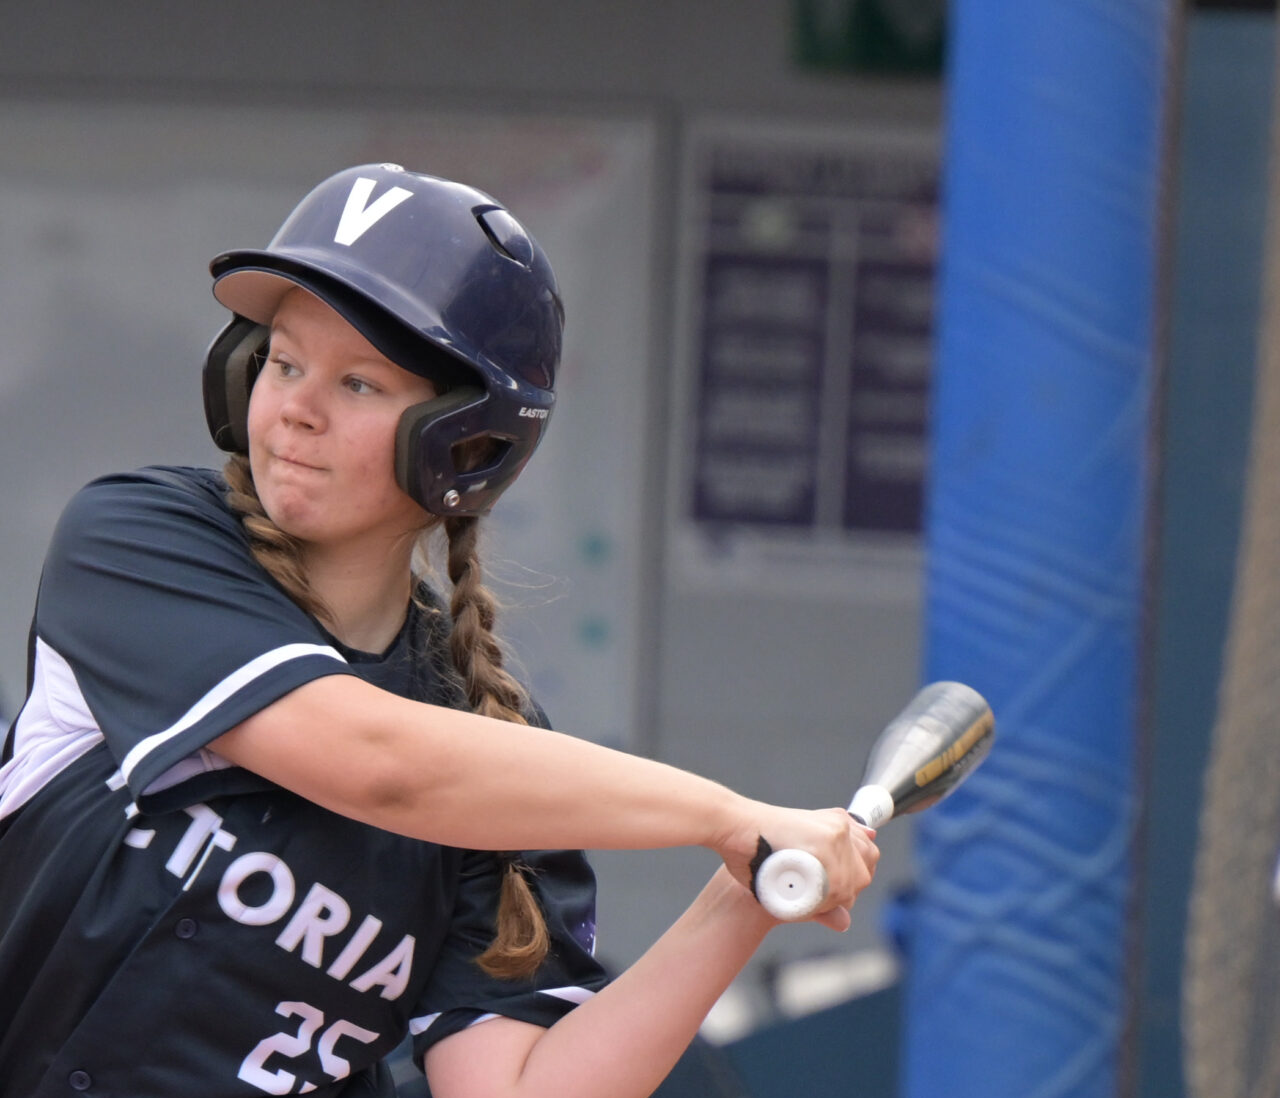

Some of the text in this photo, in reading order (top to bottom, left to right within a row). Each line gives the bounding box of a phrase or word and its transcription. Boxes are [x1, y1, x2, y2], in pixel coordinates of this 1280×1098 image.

[334, 177, 415, 247] V
[106, 769, 417, 1001] TORIA
[238, 1001, 381, 1096] 25
